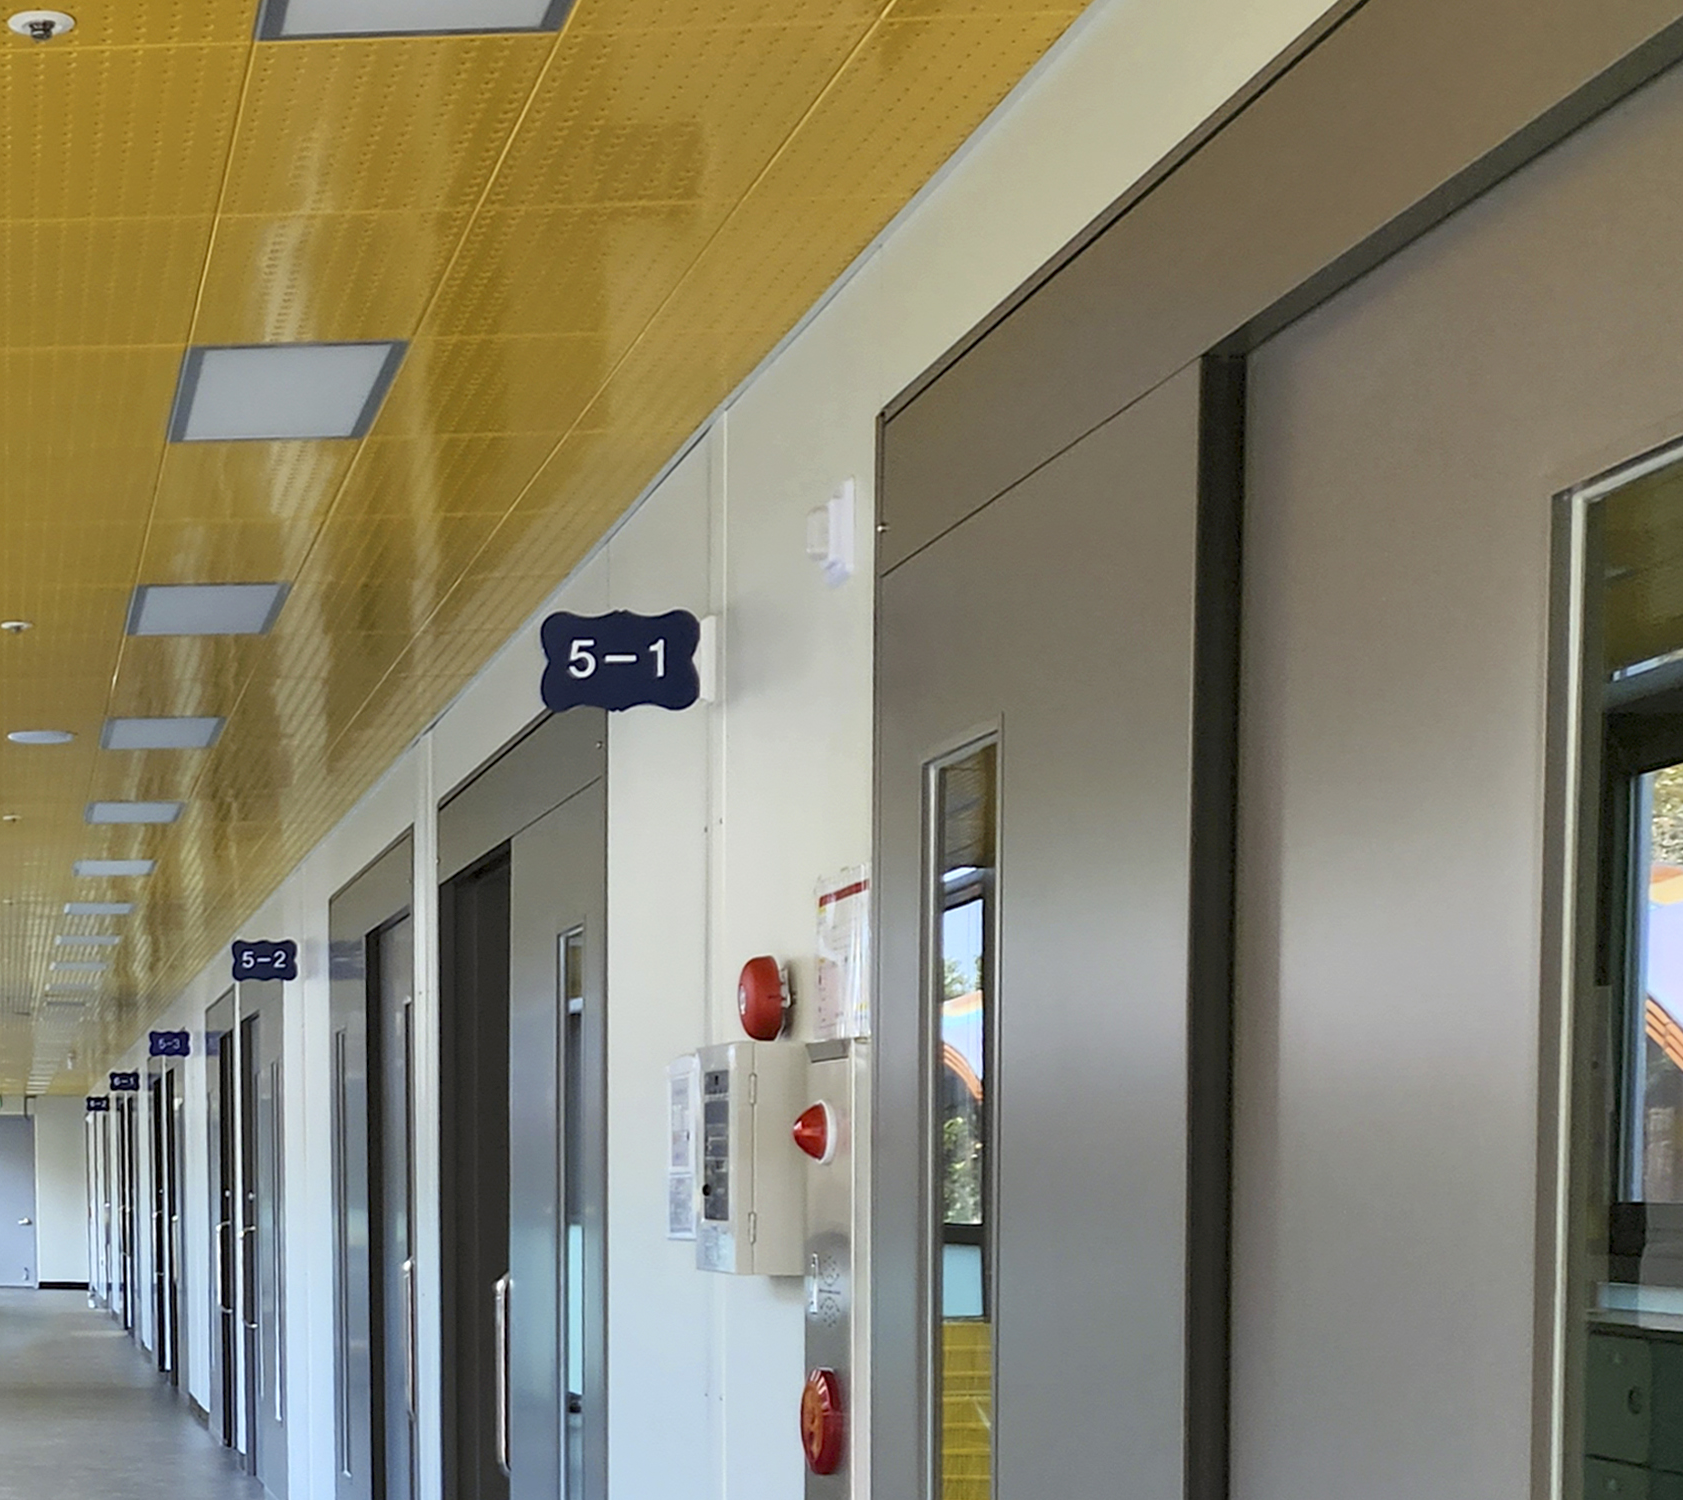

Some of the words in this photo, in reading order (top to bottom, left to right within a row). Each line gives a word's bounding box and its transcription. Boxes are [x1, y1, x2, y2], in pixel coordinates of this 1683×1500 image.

[568, 638, 665, 679] 5-1
[242, 950, 286, 968] 5-2
[158, 1038, 180, 1050] 5-3
